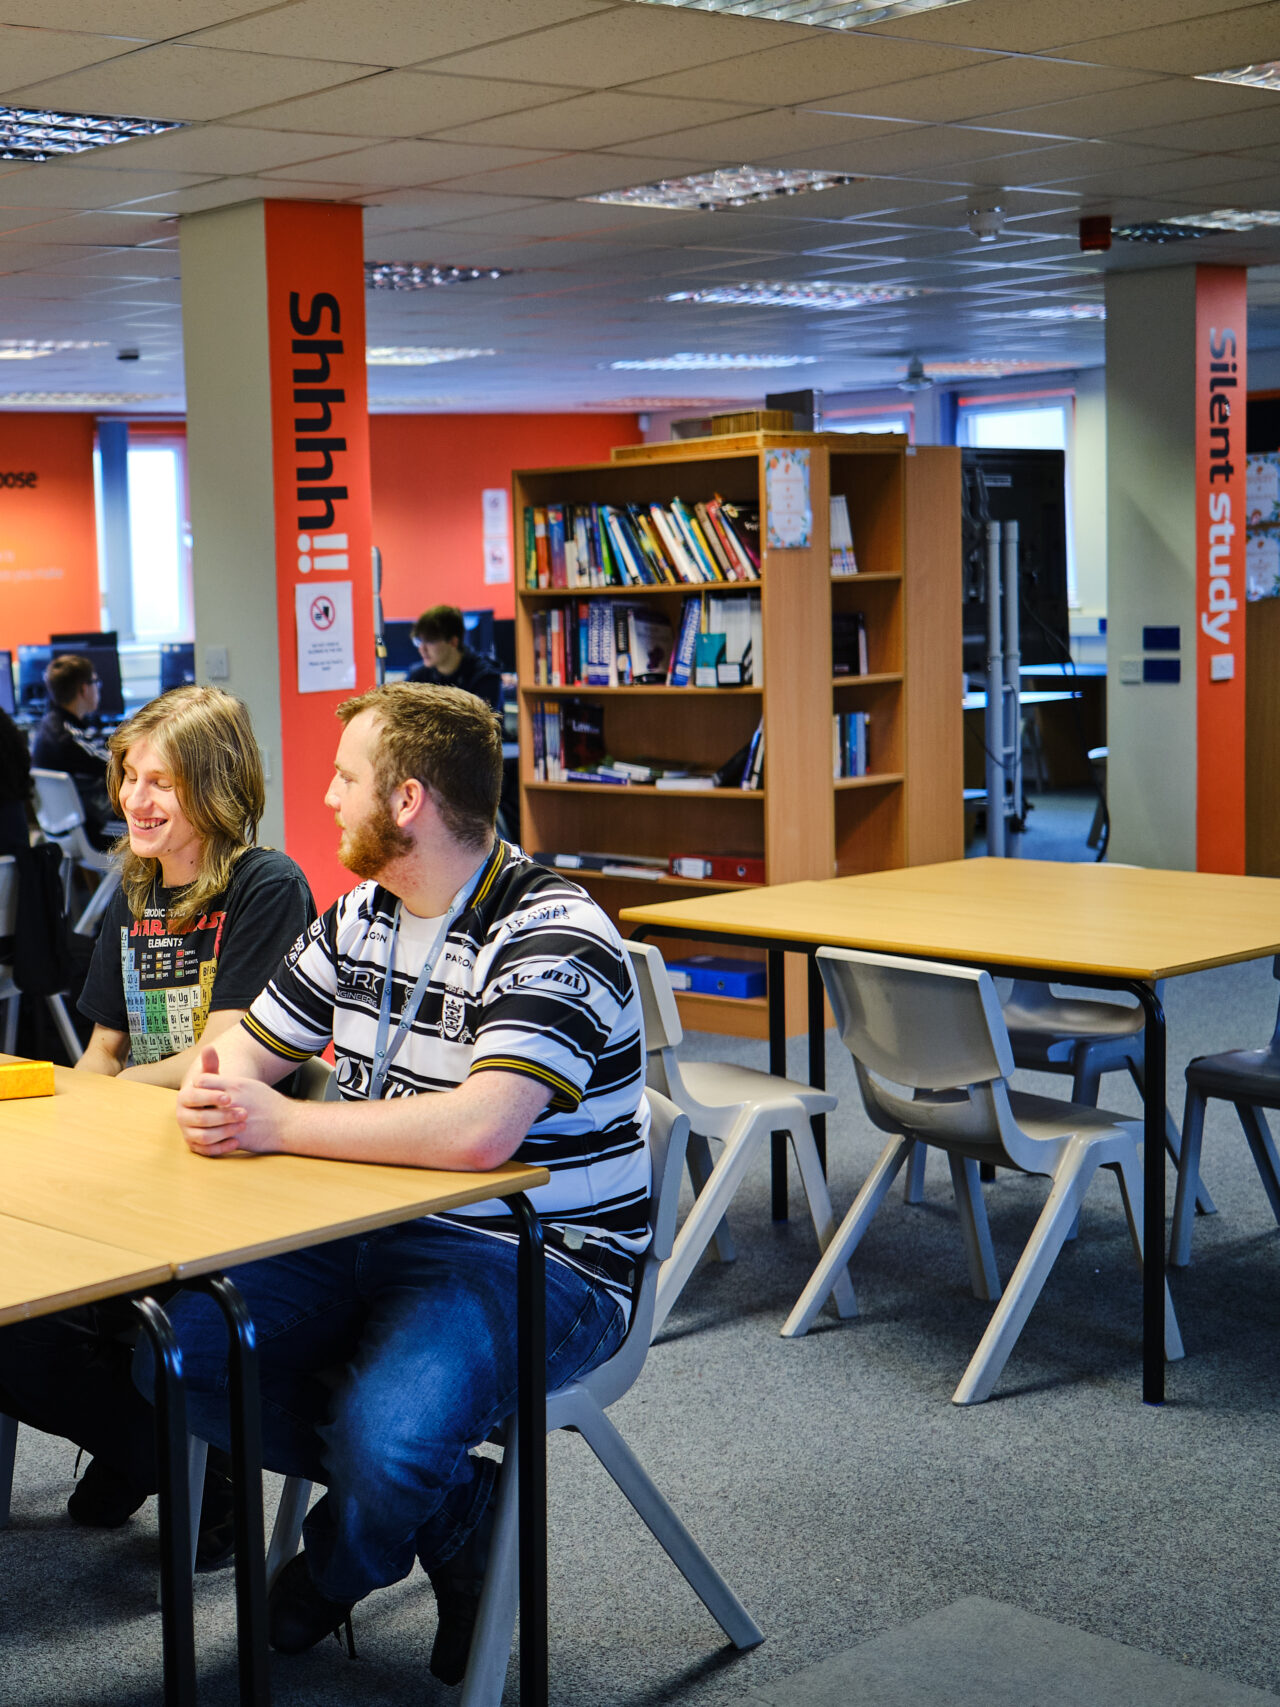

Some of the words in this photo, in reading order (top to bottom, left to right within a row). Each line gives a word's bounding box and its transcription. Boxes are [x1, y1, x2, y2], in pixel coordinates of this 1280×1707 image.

[289, 291, 349, 574] Shhhh!!
[1209, 327, 1238, 485] Silent
[1201, 492, 1238, 645] study
[130, 919, 166, 936] STAR
[148, 937, 183, 948] ELEMENTS
